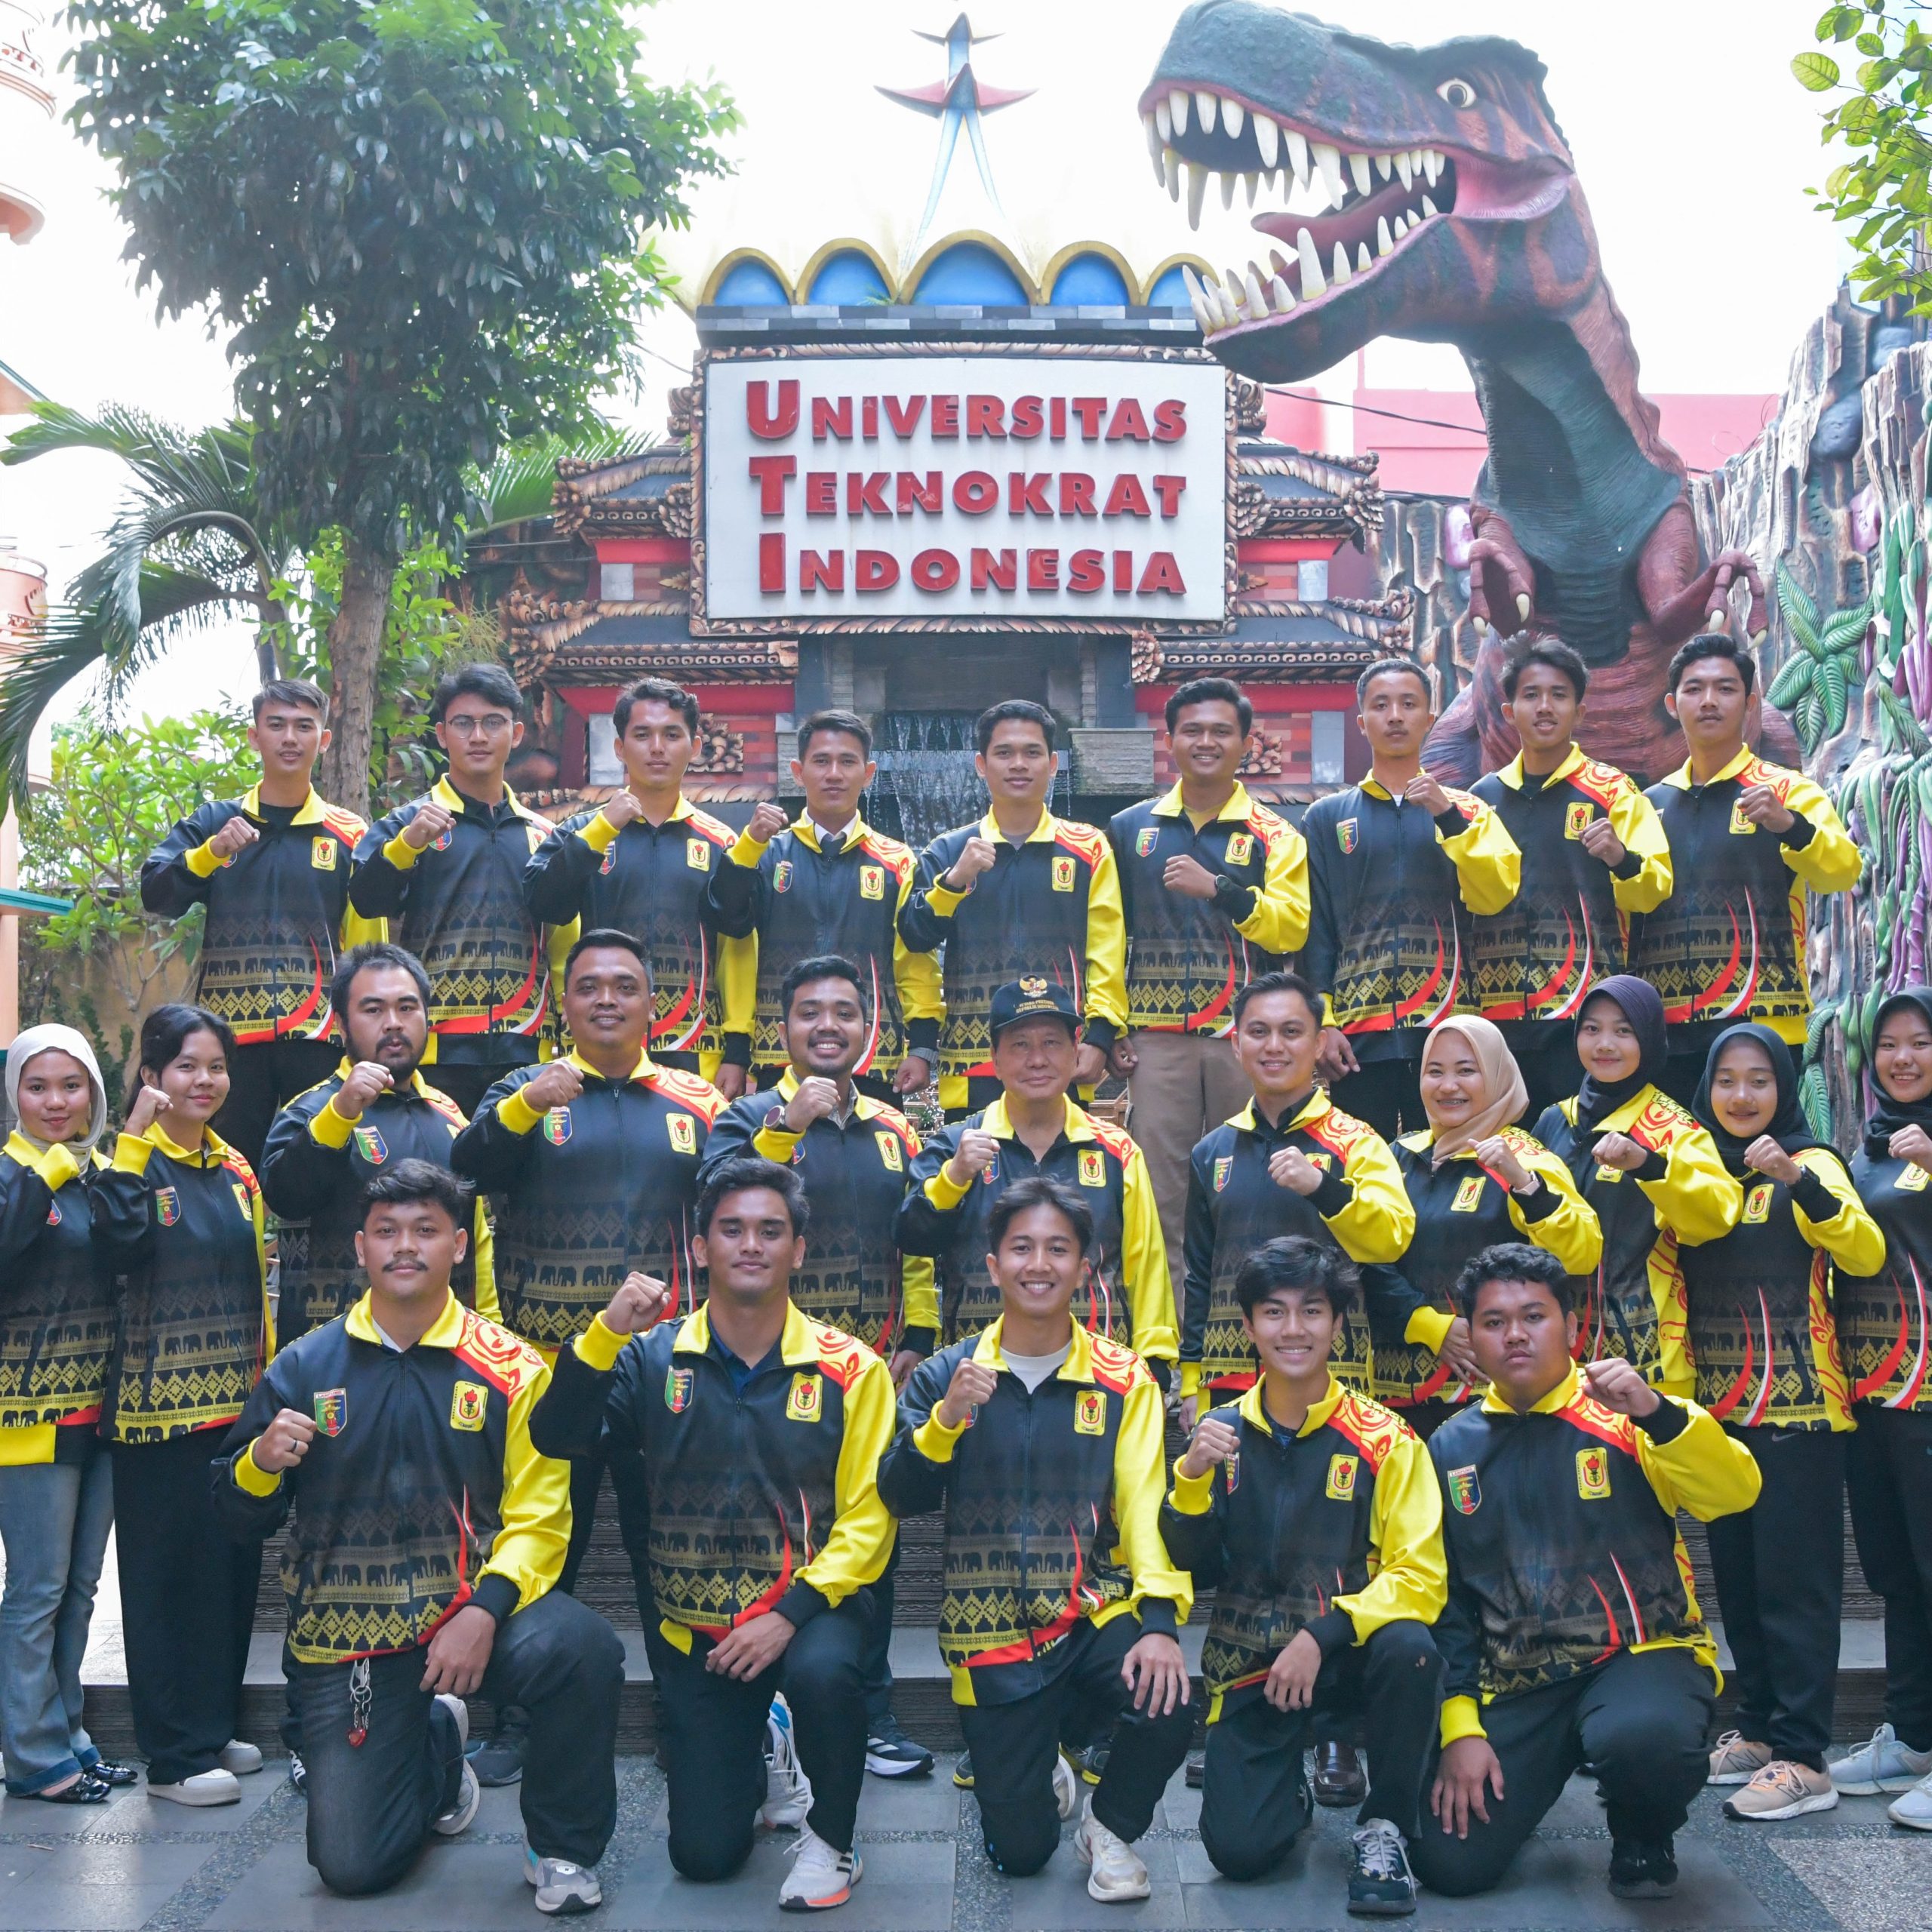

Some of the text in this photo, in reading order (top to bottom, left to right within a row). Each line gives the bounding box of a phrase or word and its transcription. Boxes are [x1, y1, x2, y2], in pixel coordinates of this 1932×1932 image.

[746, 379, 1187, 443] UNIVERSITAS
[748, 454, 1186, 517] TEKNOKRAT
[758, 532, 1187, 595] INDONESIA
